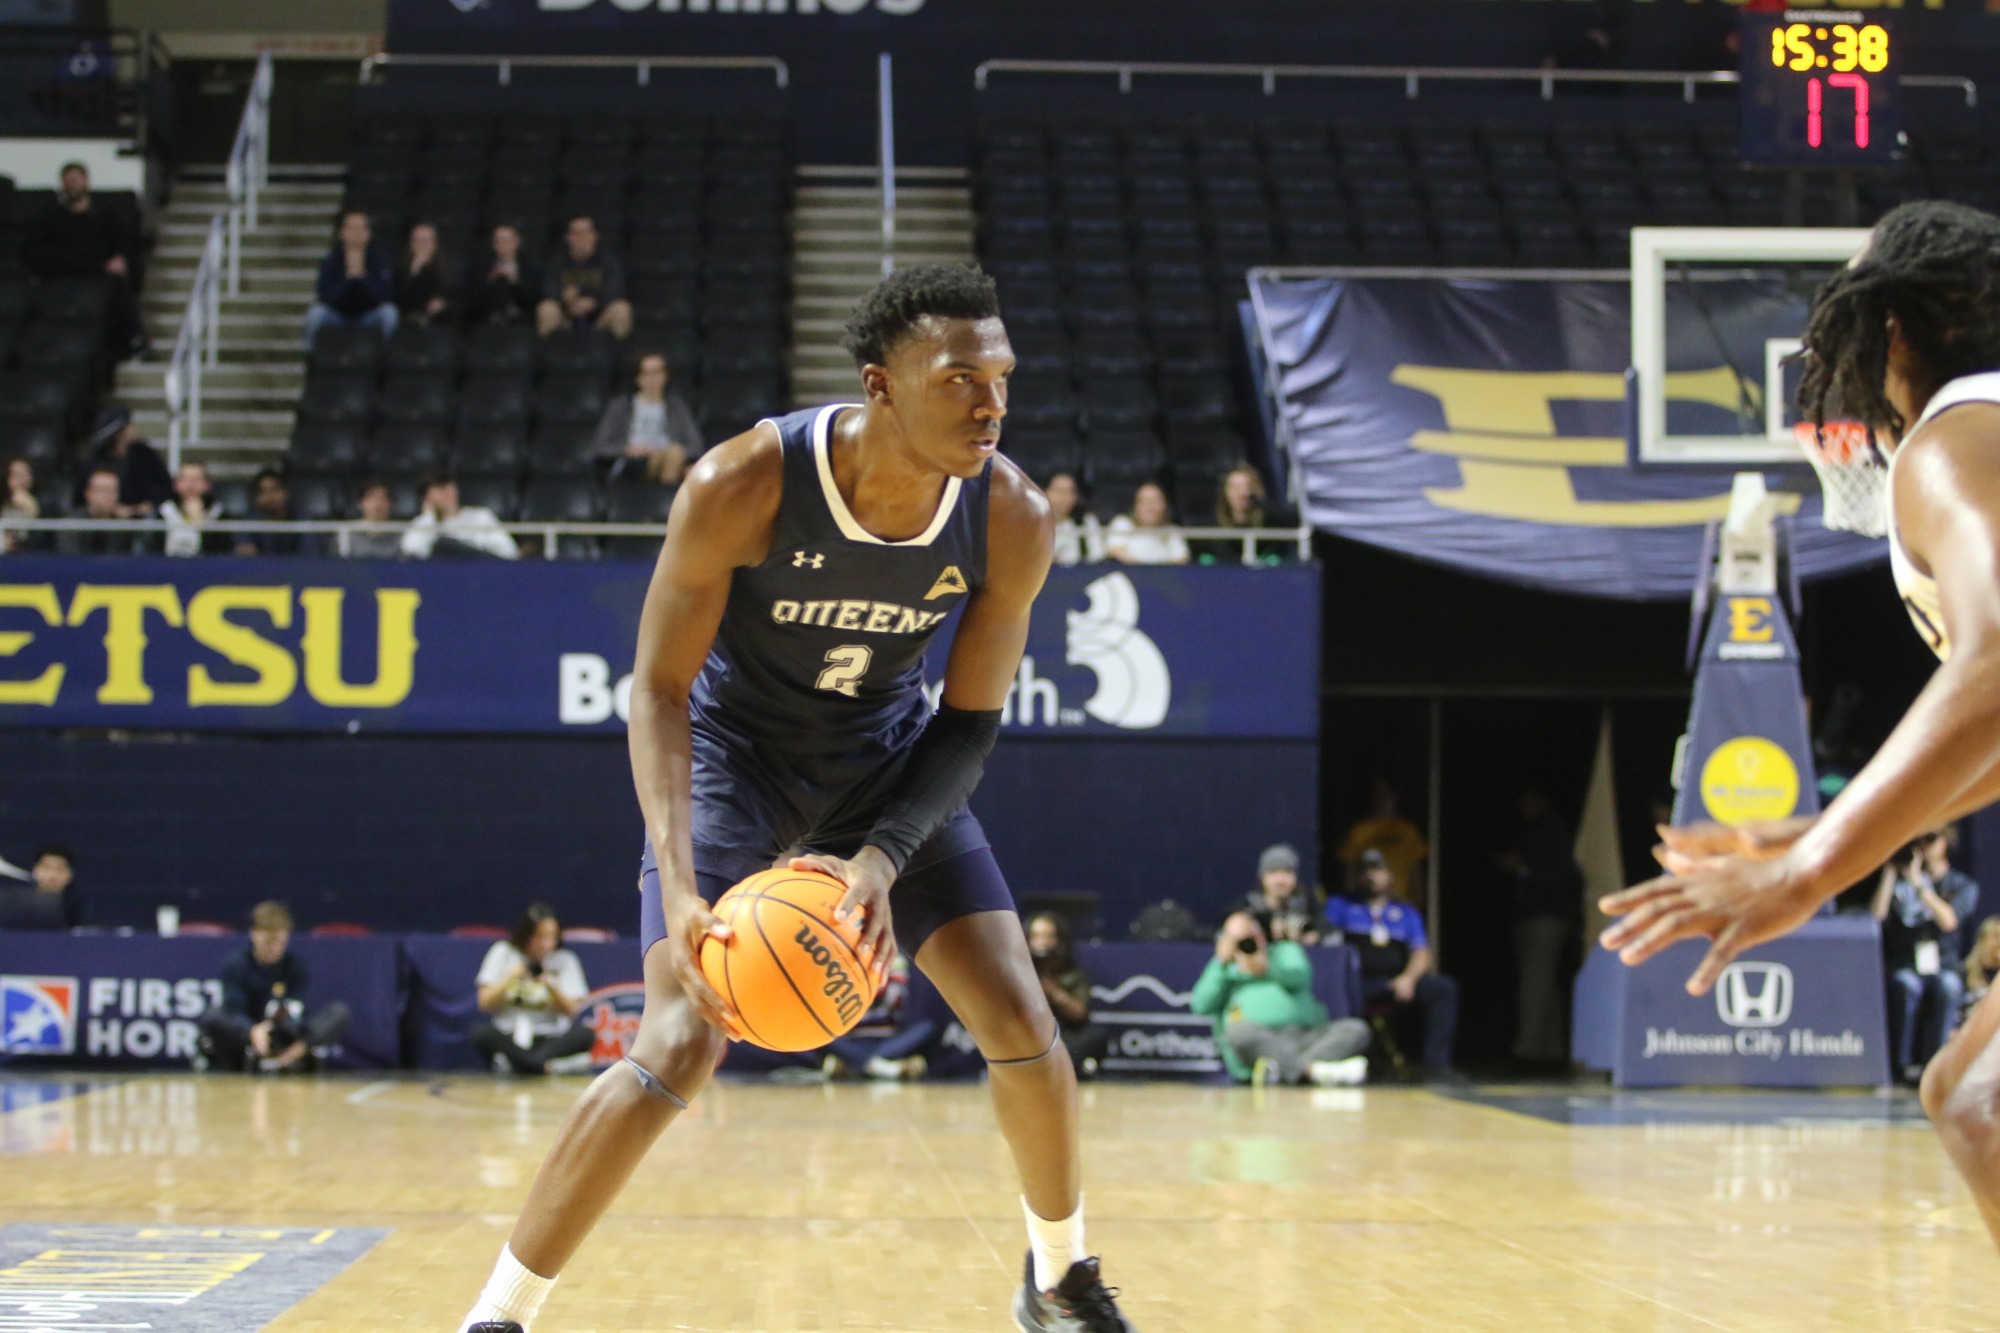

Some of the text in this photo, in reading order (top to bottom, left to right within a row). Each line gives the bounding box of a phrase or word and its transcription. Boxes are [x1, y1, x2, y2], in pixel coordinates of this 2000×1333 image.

[1772, 23, 1888, 72] 15:38
[1807, 73, 1869, 148] 17
[0, 582, 422, 708] ETSU
[815, 644, 873, 697] 2
[794, 923, 864, 1026] Wilson
[1642, 1026, 1864, 1061] Johnson City Honda
